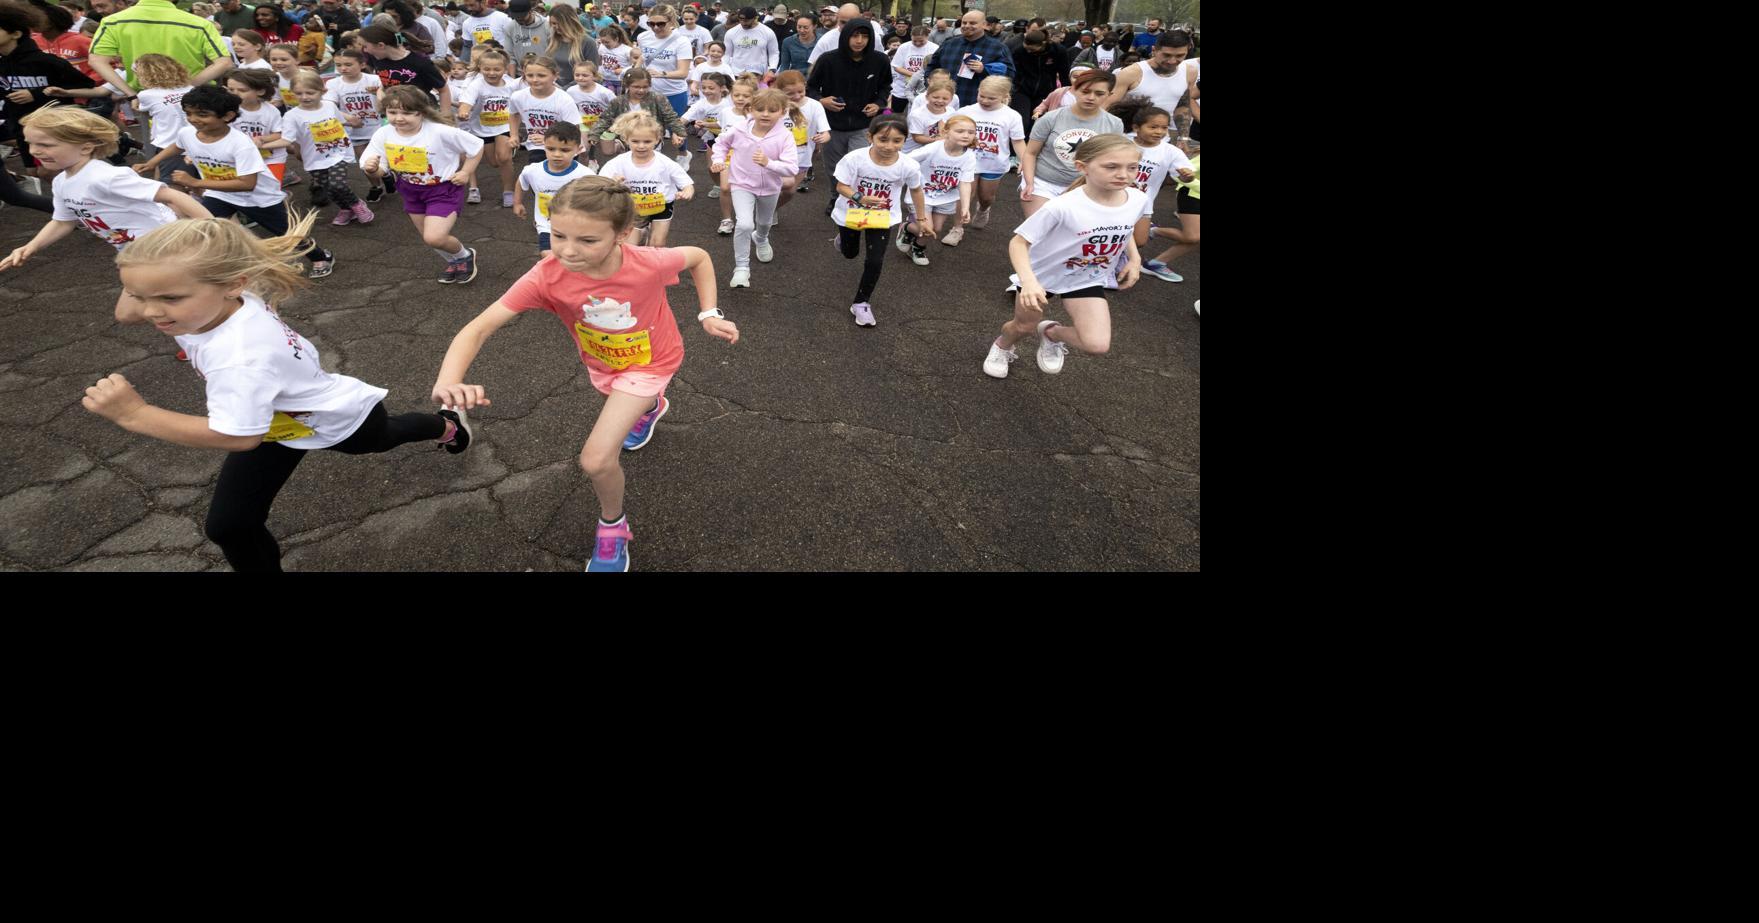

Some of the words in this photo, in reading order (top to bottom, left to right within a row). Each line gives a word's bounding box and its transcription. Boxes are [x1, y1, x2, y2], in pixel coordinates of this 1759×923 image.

[345, 100, 373, 112] RUN
[483, 103, 508, 112] RUN
[984, 126, 999, 134] BIG
[975, 132, 998, 143] UN
[945, 170, 959, 178] BIG
[859, 180, 873, 189] GO
[873, 182, 892, 191] BIG
[930, 173, 958, 188] RUN
[642, 186, 657, 194] BIG
[857, 185, 892, 199] RUN
[1092, 225, 1123, 233] MAYOR'S
[1088, 234, 1108, 245] GO
